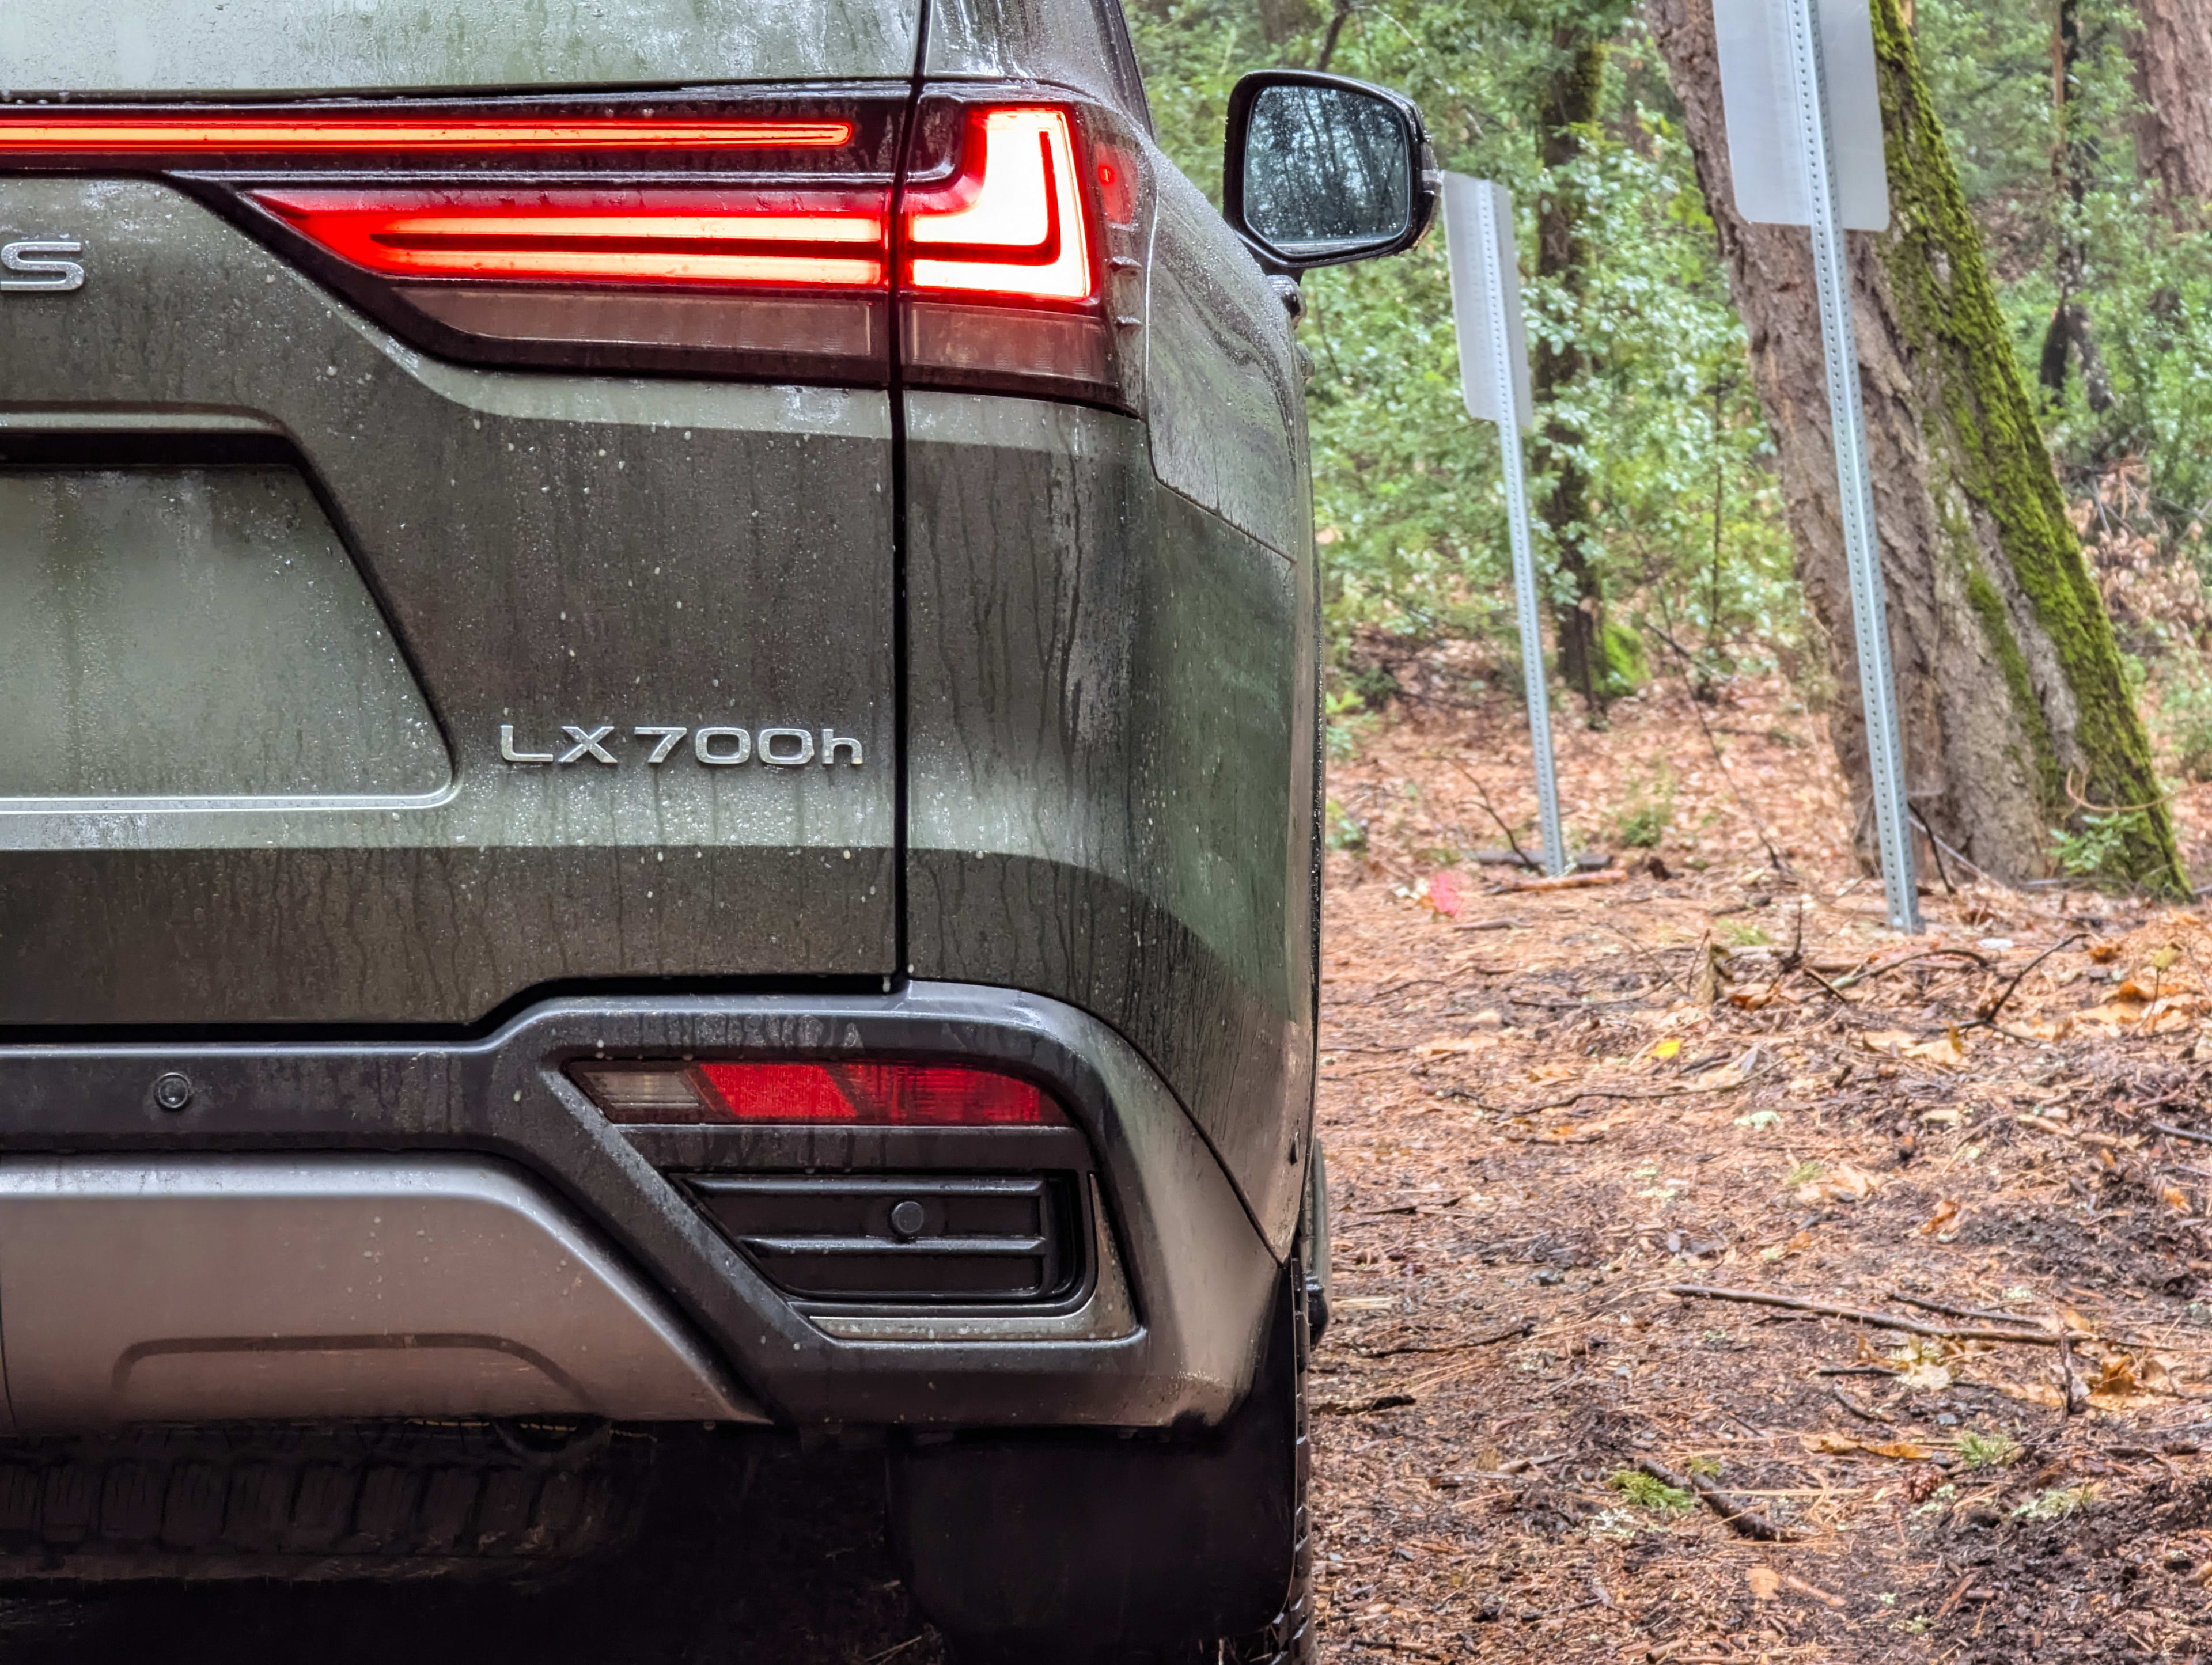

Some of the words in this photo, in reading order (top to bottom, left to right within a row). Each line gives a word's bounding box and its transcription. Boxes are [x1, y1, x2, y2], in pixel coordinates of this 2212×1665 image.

[0, 241, 85, 290] S
[500, 725, 618, 764] LX
[634, 726, 863, 765] 700h
